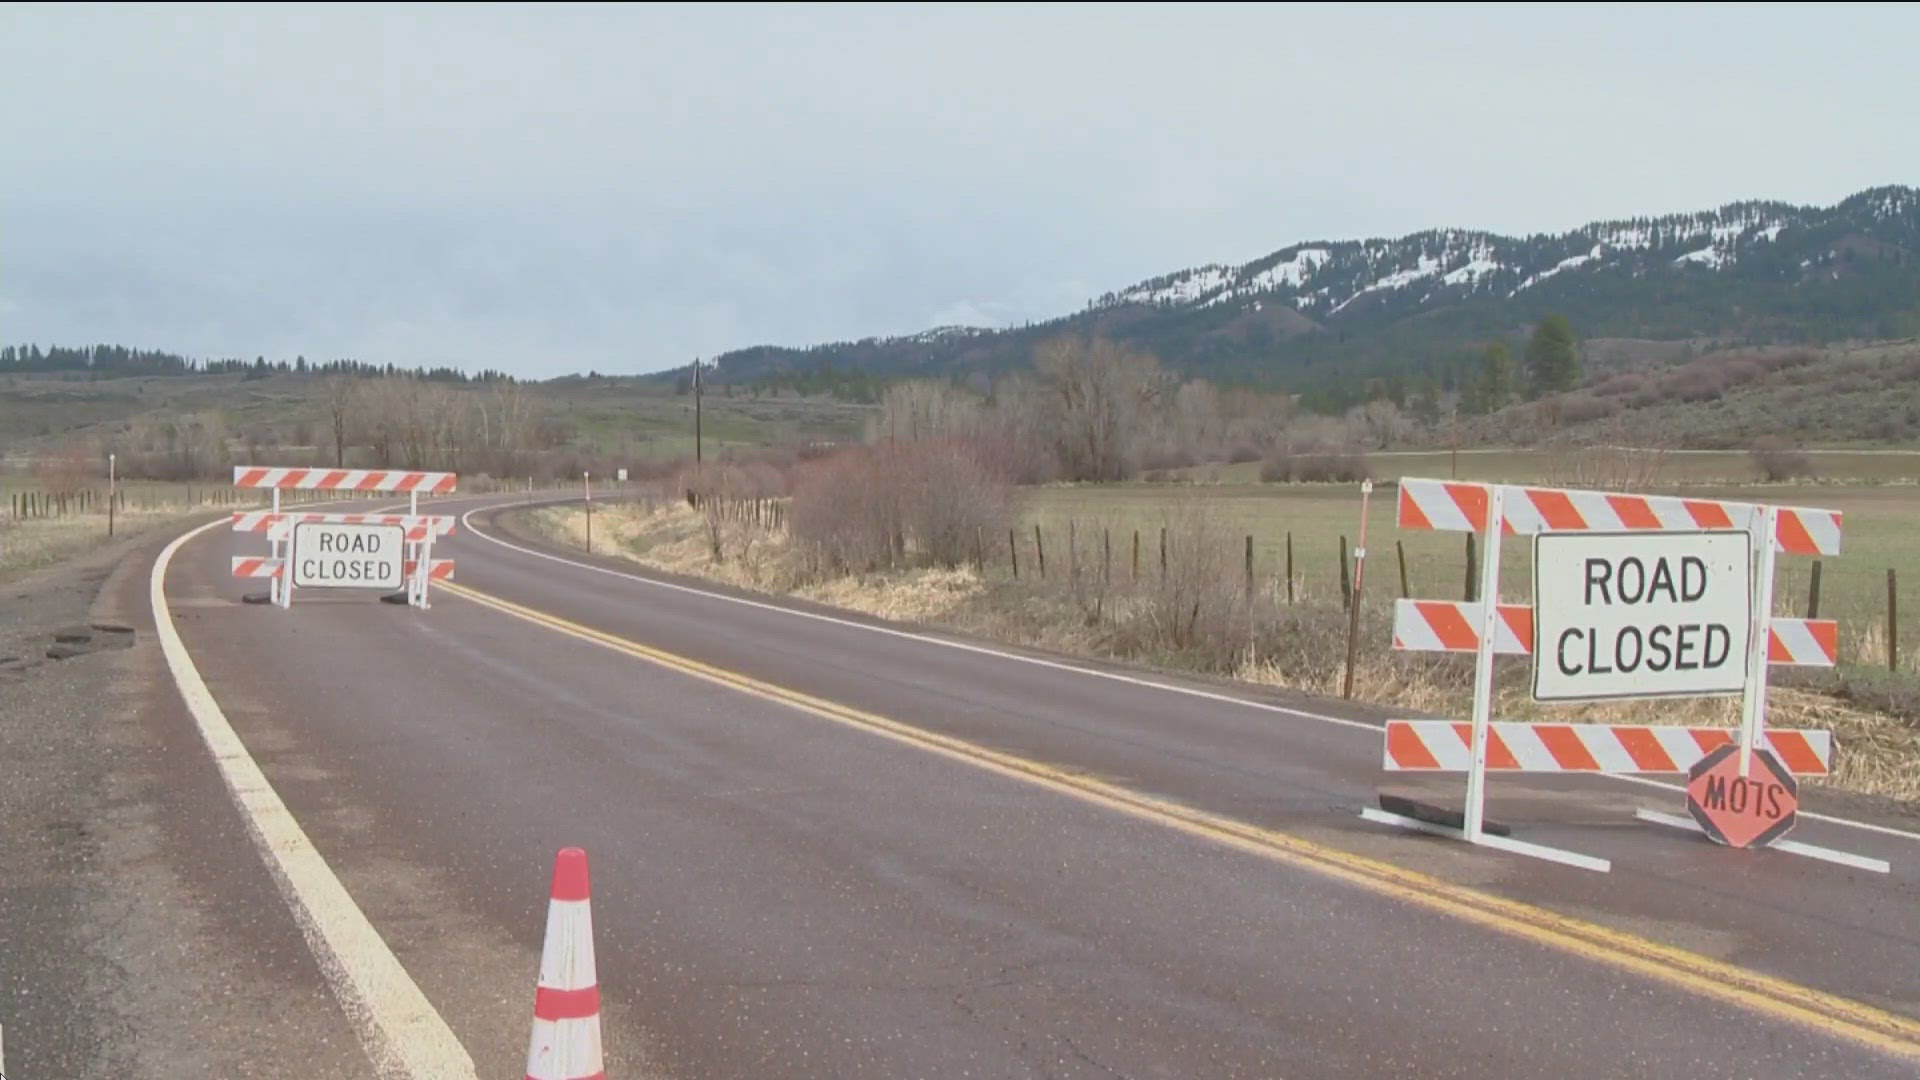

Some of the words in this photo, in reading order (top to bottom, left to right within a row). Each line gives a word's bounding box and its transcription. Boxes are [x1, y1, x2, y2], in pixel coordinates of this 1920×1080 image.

[320, 533, 380, 553] ROAD
[303, 560, 391, 580] CLOSED
[1584, 556, 1707, 605] ROAD
[1557, 623, 1731, 676] CLOSED
[1702, 775, 1784, 820] SLOW
